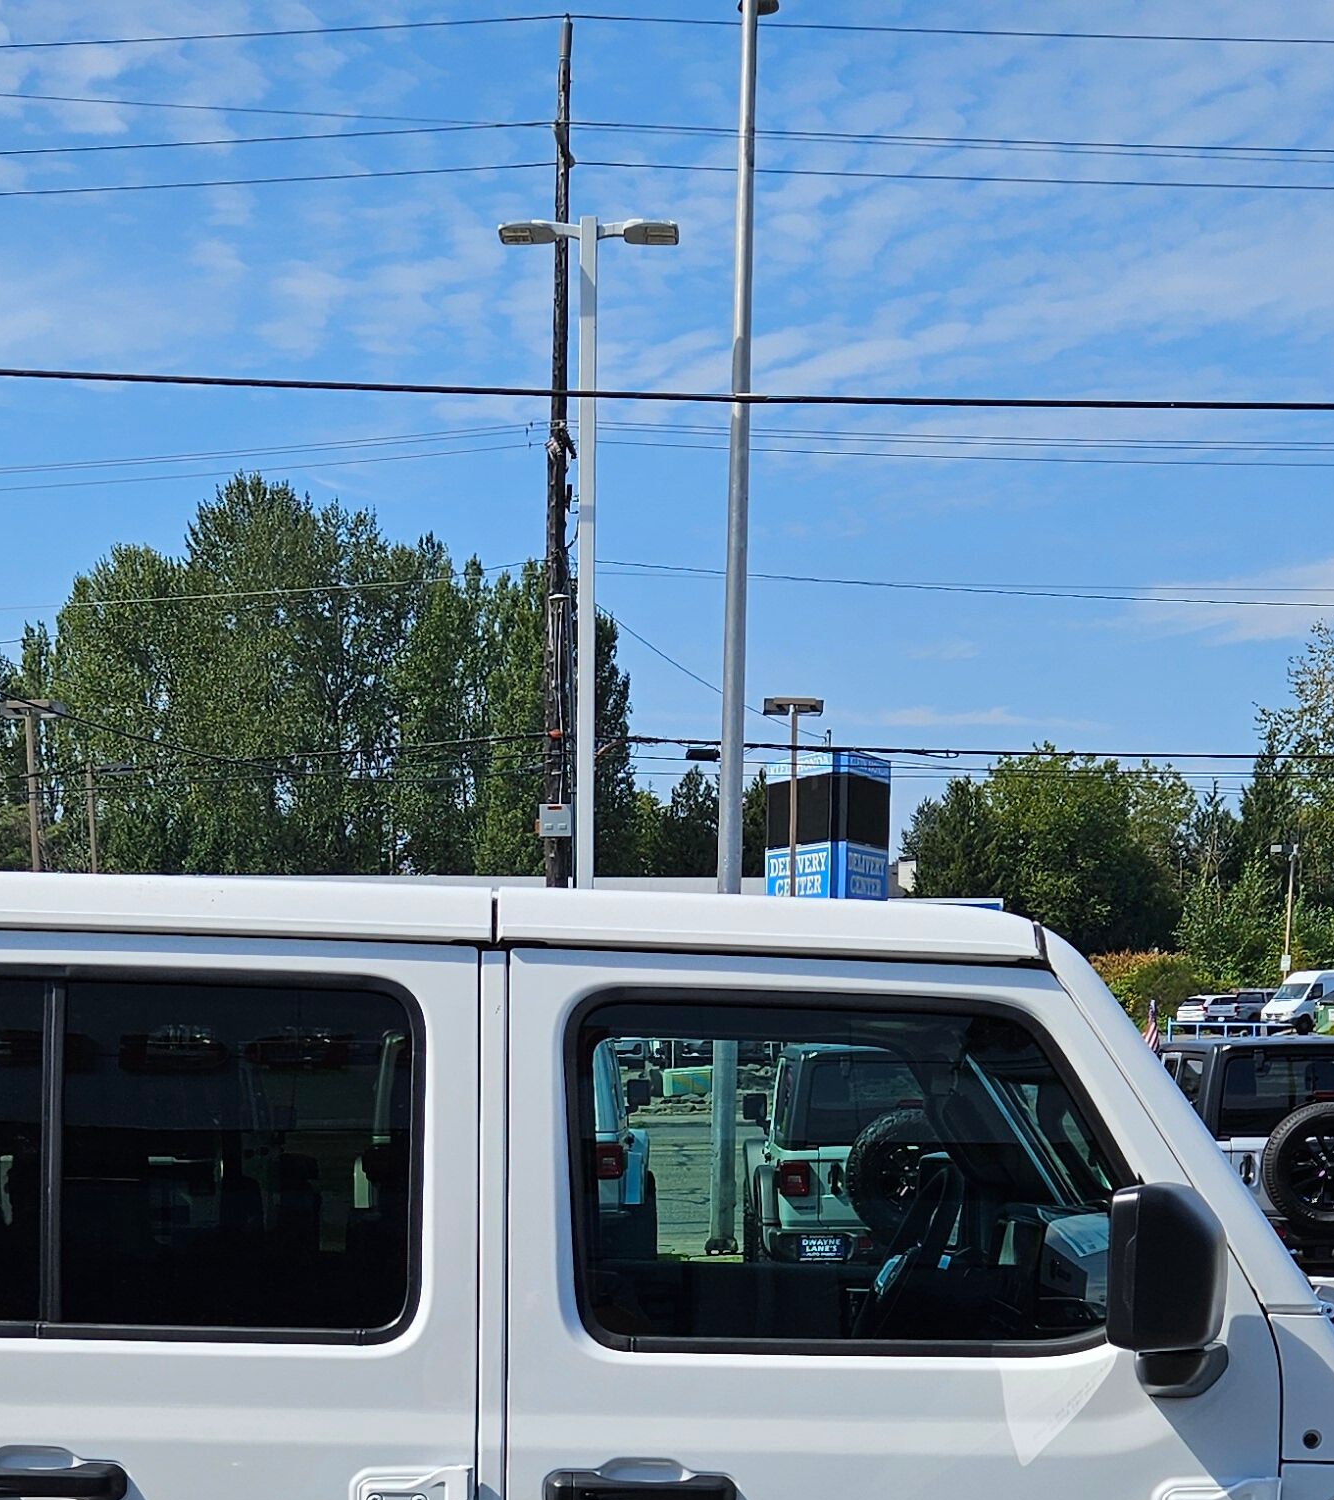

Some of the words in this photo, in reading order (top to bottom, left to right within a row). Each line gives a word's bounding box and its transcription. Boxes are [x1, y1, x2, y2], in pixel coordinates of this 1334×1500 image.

[769, 851, 827, 877] DELVERY
[850, 875, 882, 896] CENTER
[801, 1238, 842, 1246] DWAYNE
